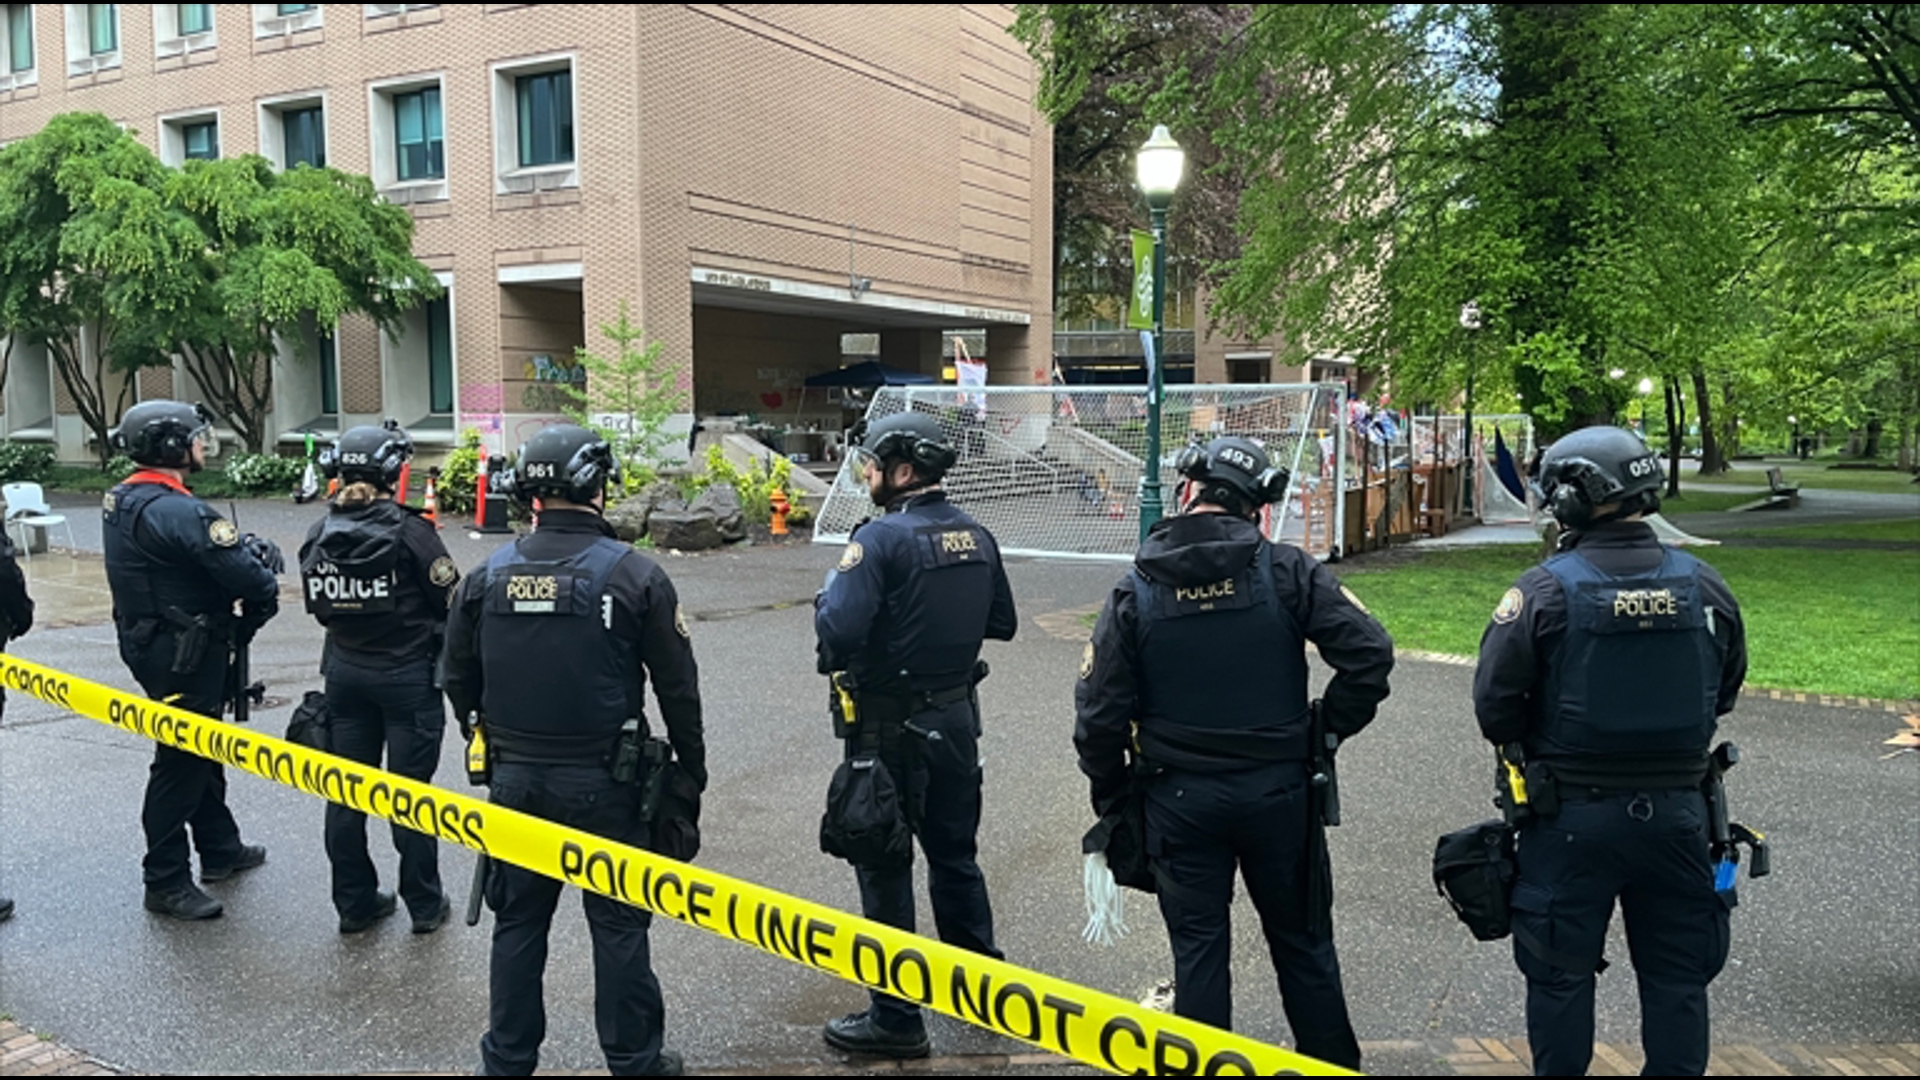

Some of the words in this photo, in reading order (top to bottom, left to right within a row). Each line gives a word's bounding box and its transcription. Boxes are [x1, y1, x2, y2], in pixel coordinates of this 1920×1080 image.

[1220, 448, 1255, 469] 493
[1630, 457, 1656, 477] 051
[527, 463, 554, 478] 961
[308, 575, 389, 600] POLICE
[507, 582, 558, 599] POLICE
[1176, 578, 1235, 602] POLICE
[1614, 598, 1677, 616] POLICE
[5, 665, 74, 711] CROSS
[109, 699, 190, 745] POLICE
[195, 726, 250, 769] LINE
[255, 746, 298, 789] DO
[302, 761, 364, 809] NOT
[369, 781, 489, 852] CROSS
[560, 841, 714, 932] POLICE
[728, 894, 840, 974] LINE
[852, 933, 933, 1005] DO
[951, 964, 1085, 1054] NOT
[1100, 1016, 1304, 1077] CRO
